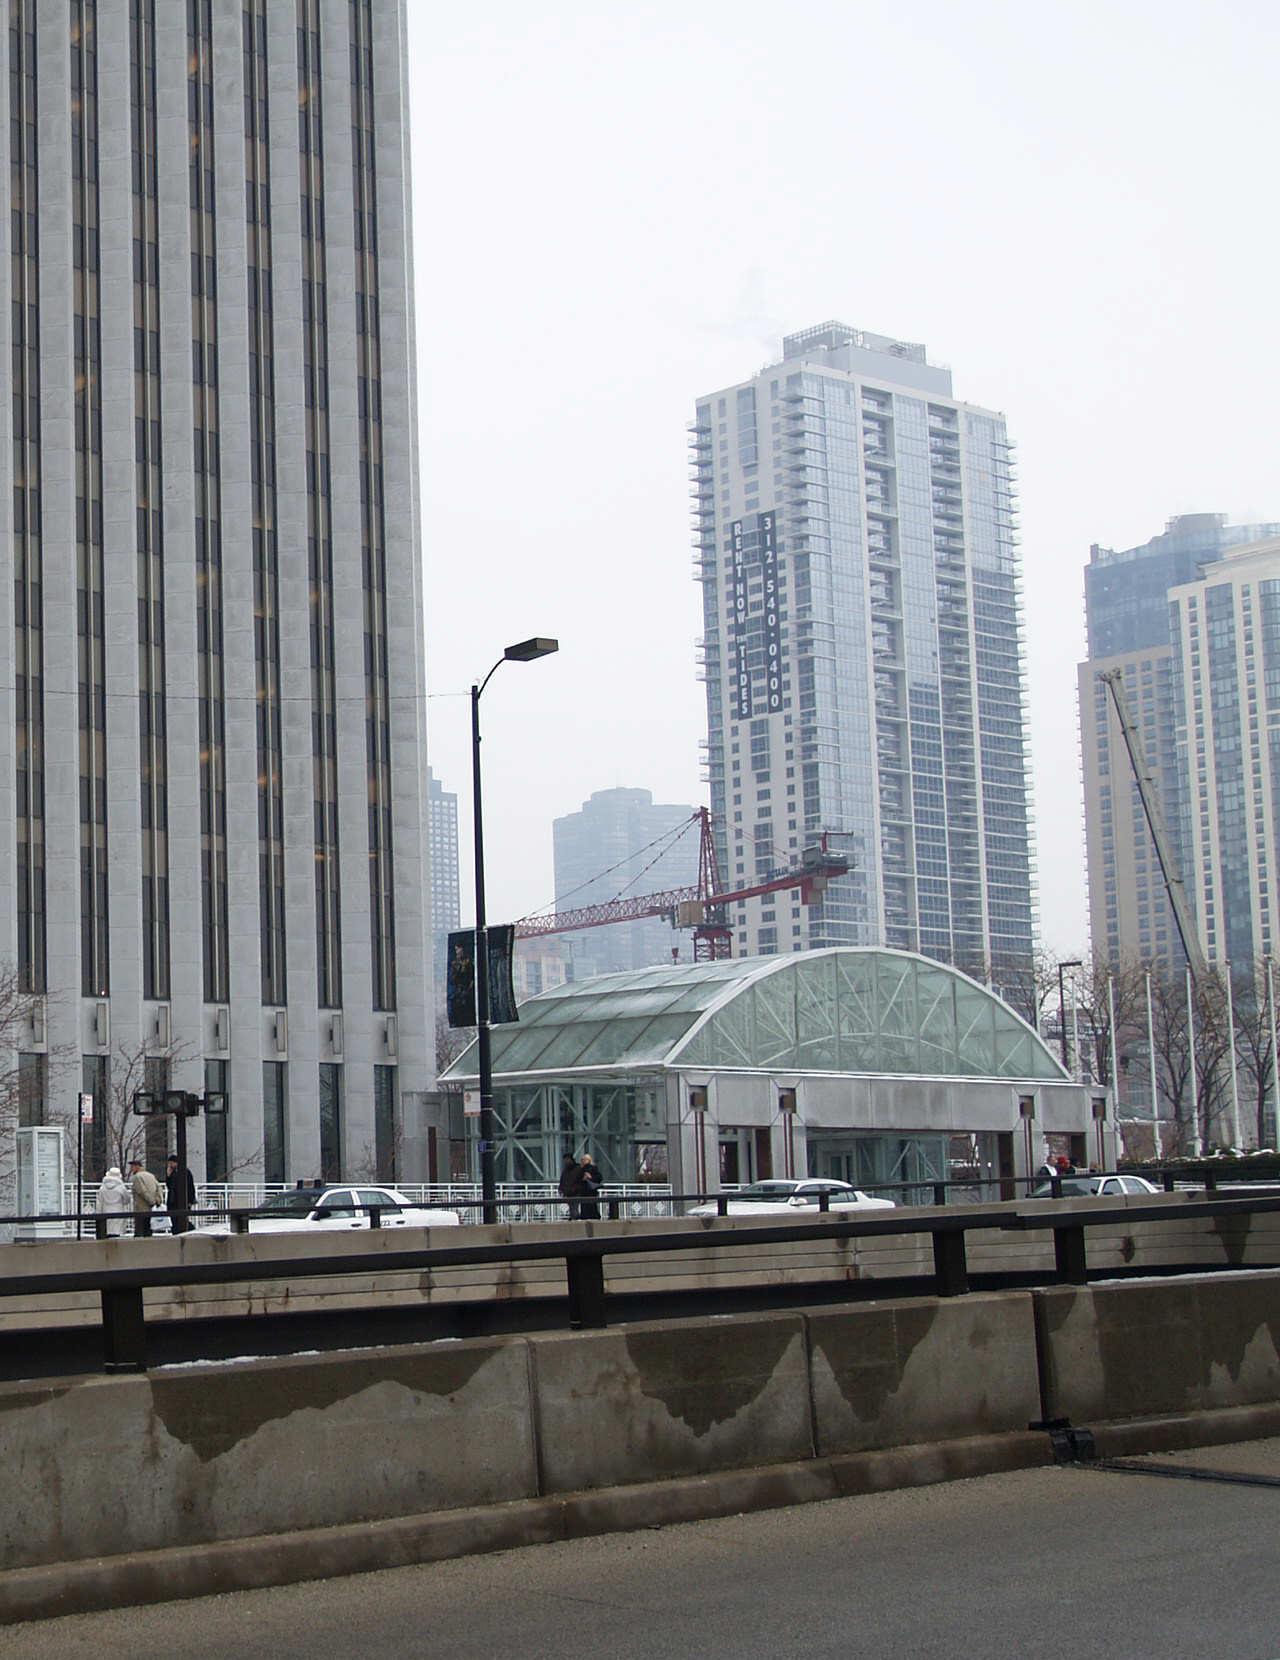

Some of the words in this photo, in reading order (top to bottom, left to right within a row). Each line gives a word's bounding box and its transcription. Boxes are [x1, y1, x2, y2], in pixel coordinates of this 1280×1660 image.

[734, 522, 743, 578] RENT
[736, 583, 746, 625] NOW
[739, 645, 748, 715] TIDES
